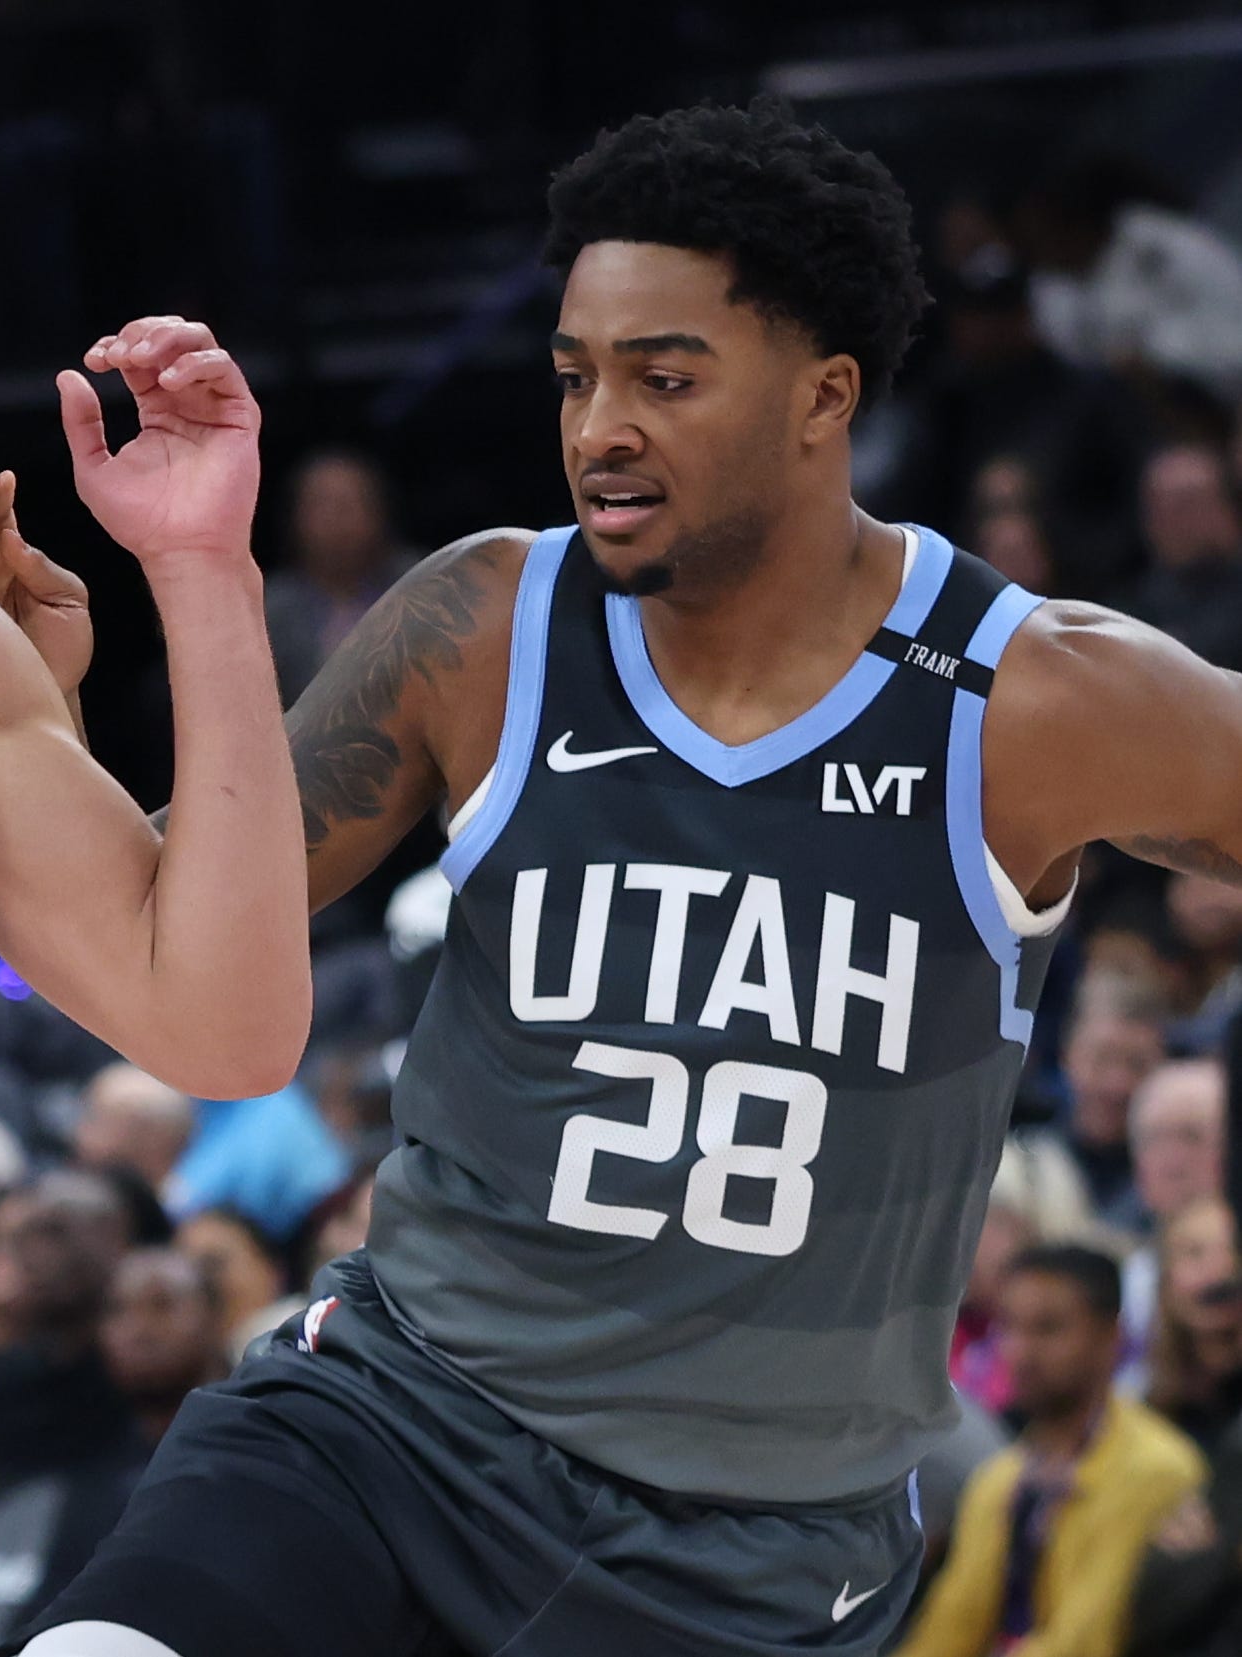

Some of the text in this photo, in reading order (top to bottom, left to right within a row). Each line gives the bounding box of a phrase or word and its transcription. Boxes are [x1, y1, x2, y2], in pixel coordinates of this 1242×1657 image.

[904, 642, 961, 680] FRANK
[822, 763, 927, 816] LVT
[509, 863, 920, 1074] UTAH
[547, 1041, 828, 1257] 28
